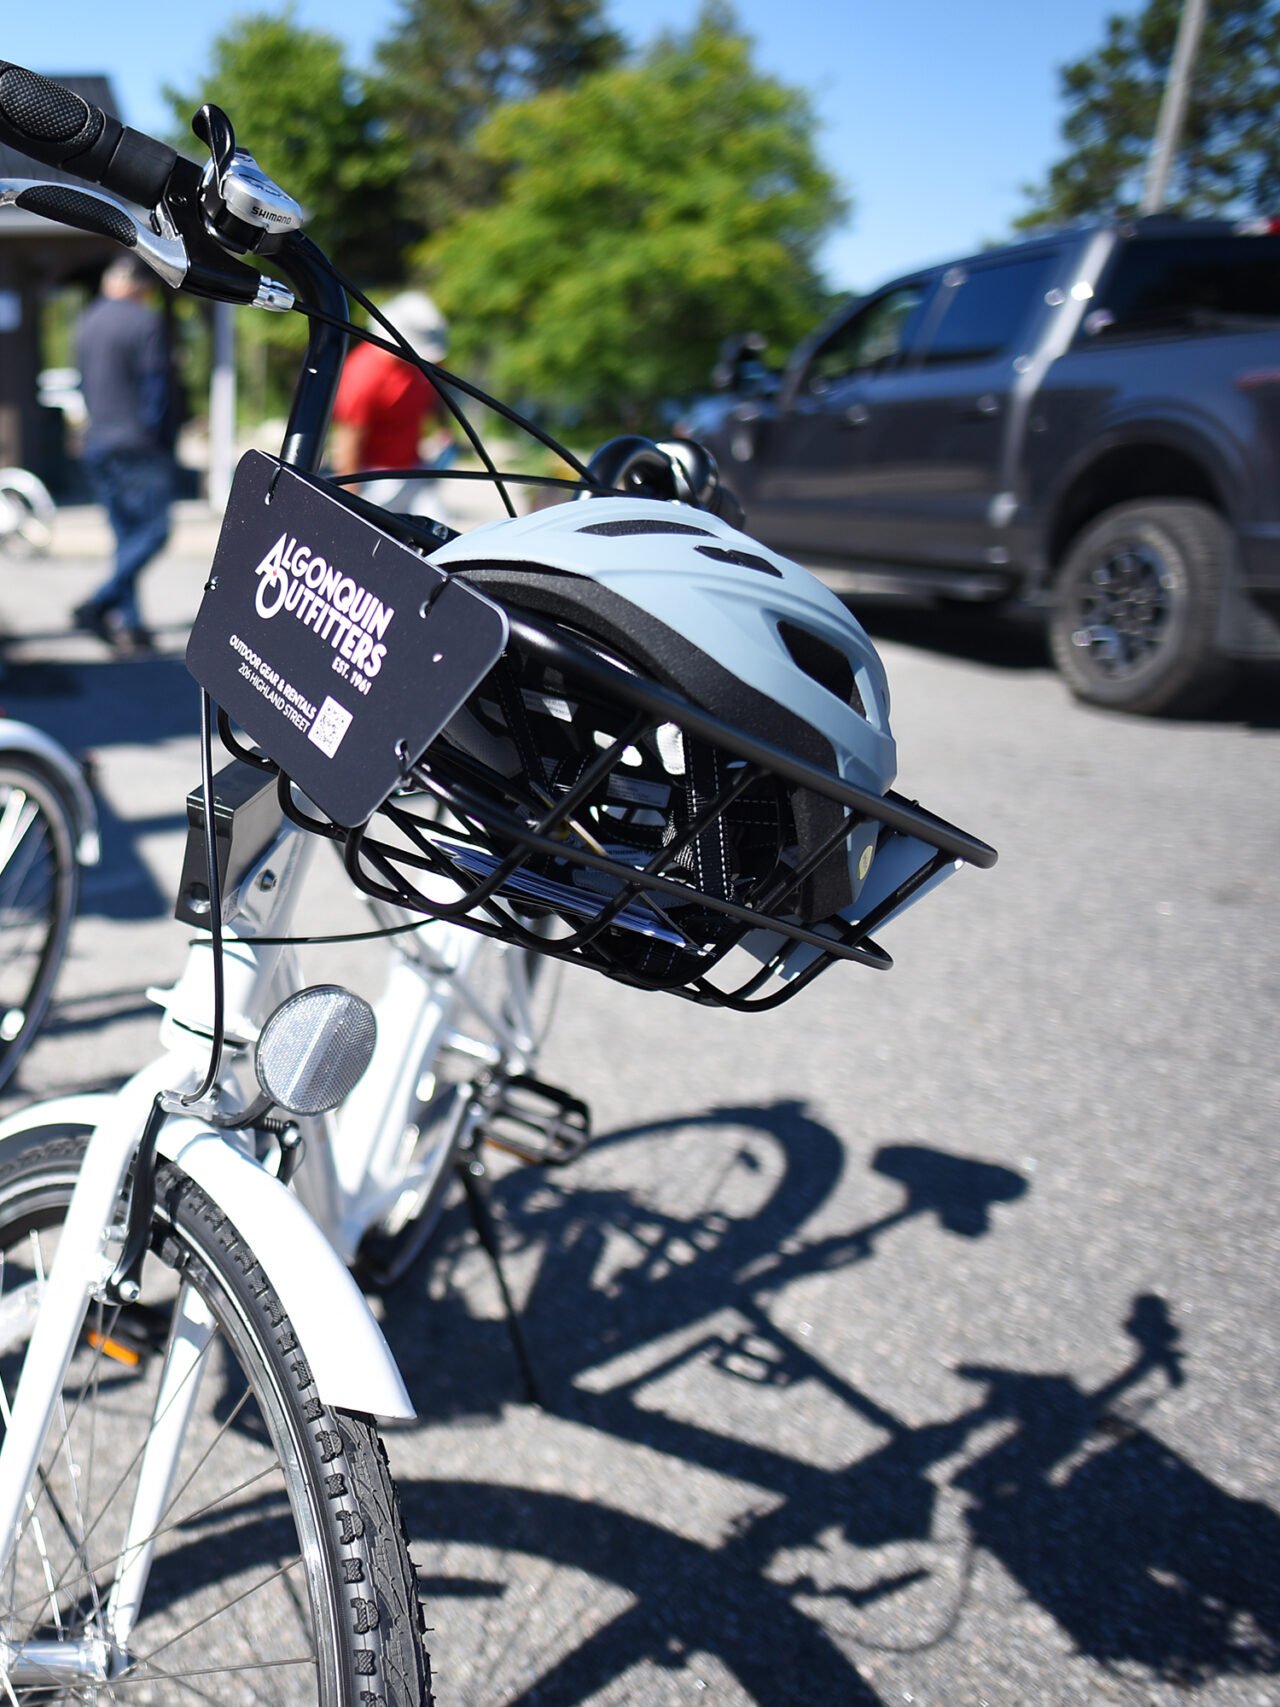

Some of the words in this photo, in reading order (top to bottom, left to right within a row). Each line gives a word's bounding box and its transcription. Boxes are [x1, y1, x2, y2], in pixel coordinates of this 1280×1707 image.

[251, 206, 292, 225] SHIMANO
[254, 532, 395, 641] ALGONQUIN
[255, 567, 388, 678] OUTFITTERS
[229, 634, 262, 670] OUTDOOR
[259, 662, 281, 687] GEAR
[276, 678, 286, 692] &
[282, 683, 318, 720] RENTALS
[237, 662, 252, 680] 206
[248, 672, 285, 711] HIGHLAND
[282, 704, 311, 733] STREET
[331, 656, 350, 680] EST.
[349, 670, 372, 696] 1961
